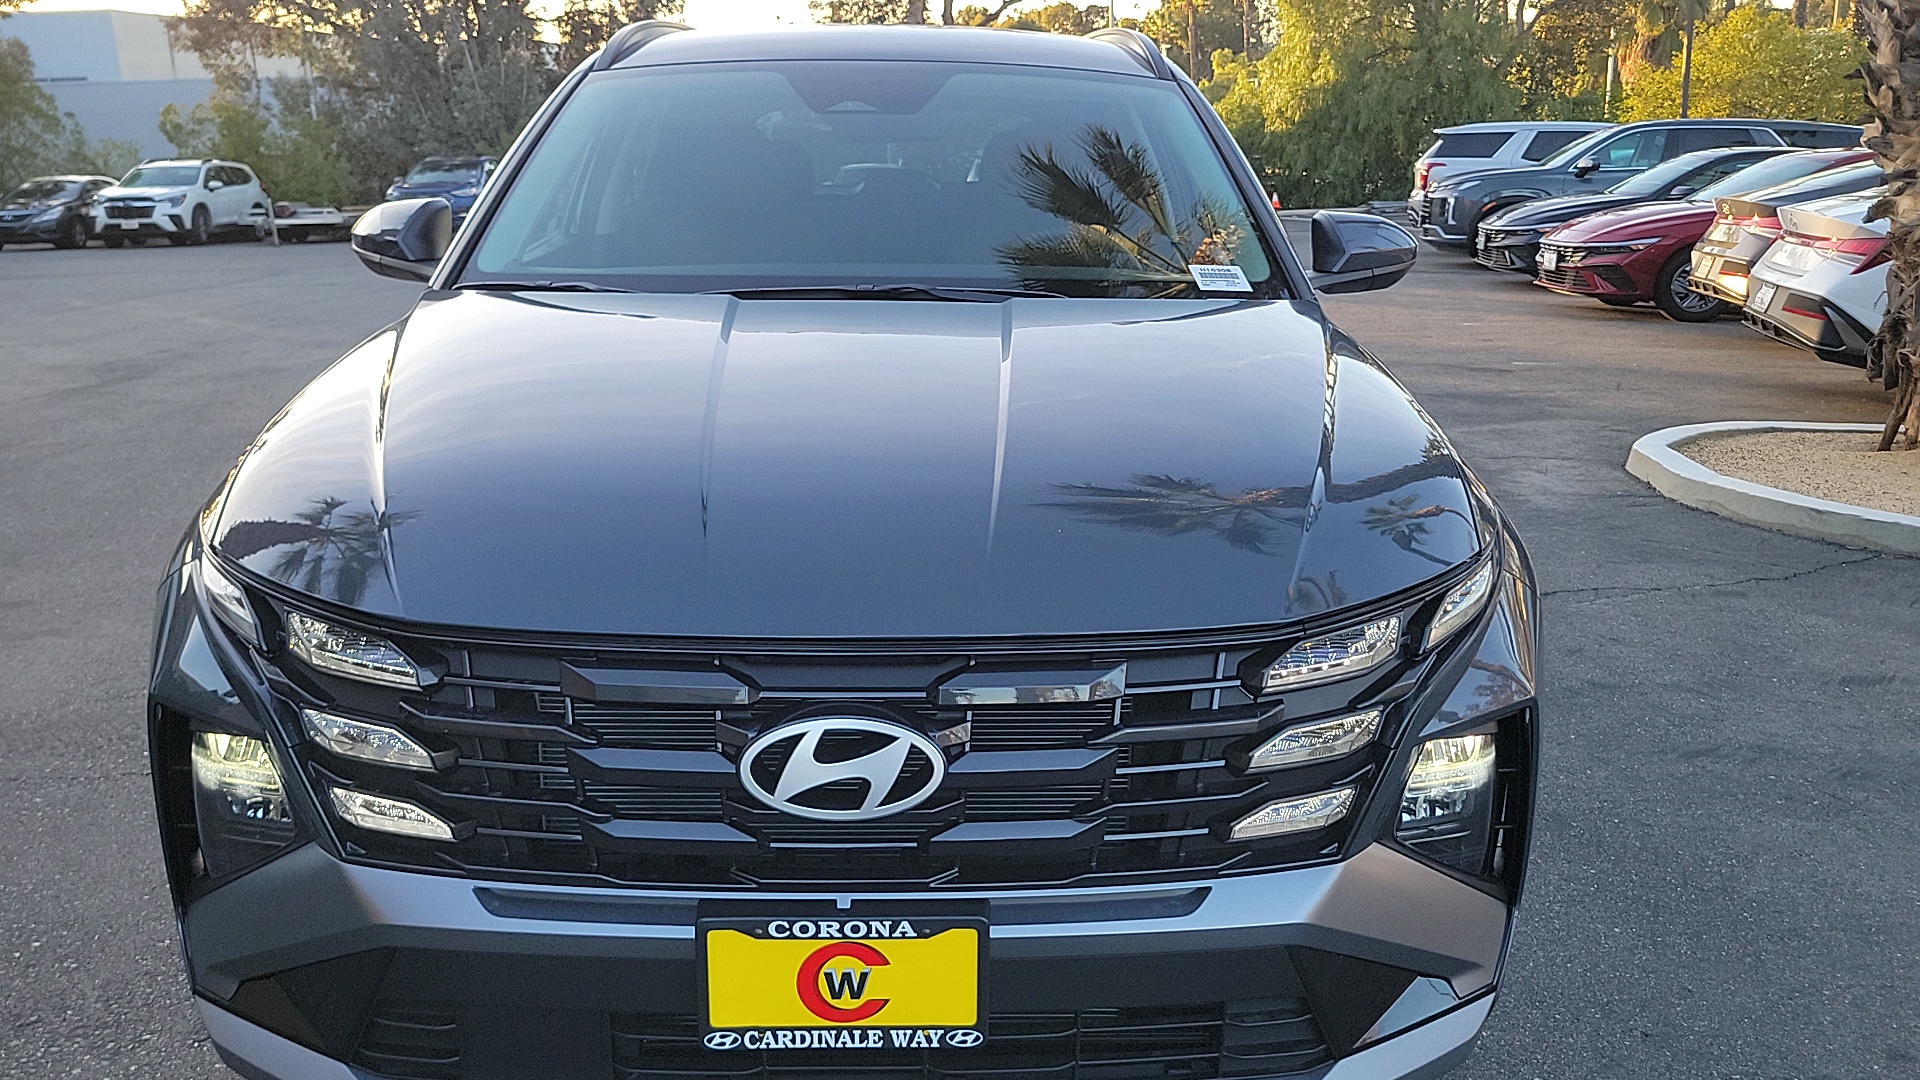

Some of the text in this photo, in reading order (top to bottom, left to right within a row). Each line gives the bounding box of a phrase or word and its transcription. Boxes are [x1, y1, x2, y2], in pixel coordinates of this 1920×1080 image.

[767, 920, 918, 938] CORONA
[796, 941, 891, 1023] C
[823, 967, 872, 1000] W
[743, 1029, 945, 1049] CARDINALE WAY
